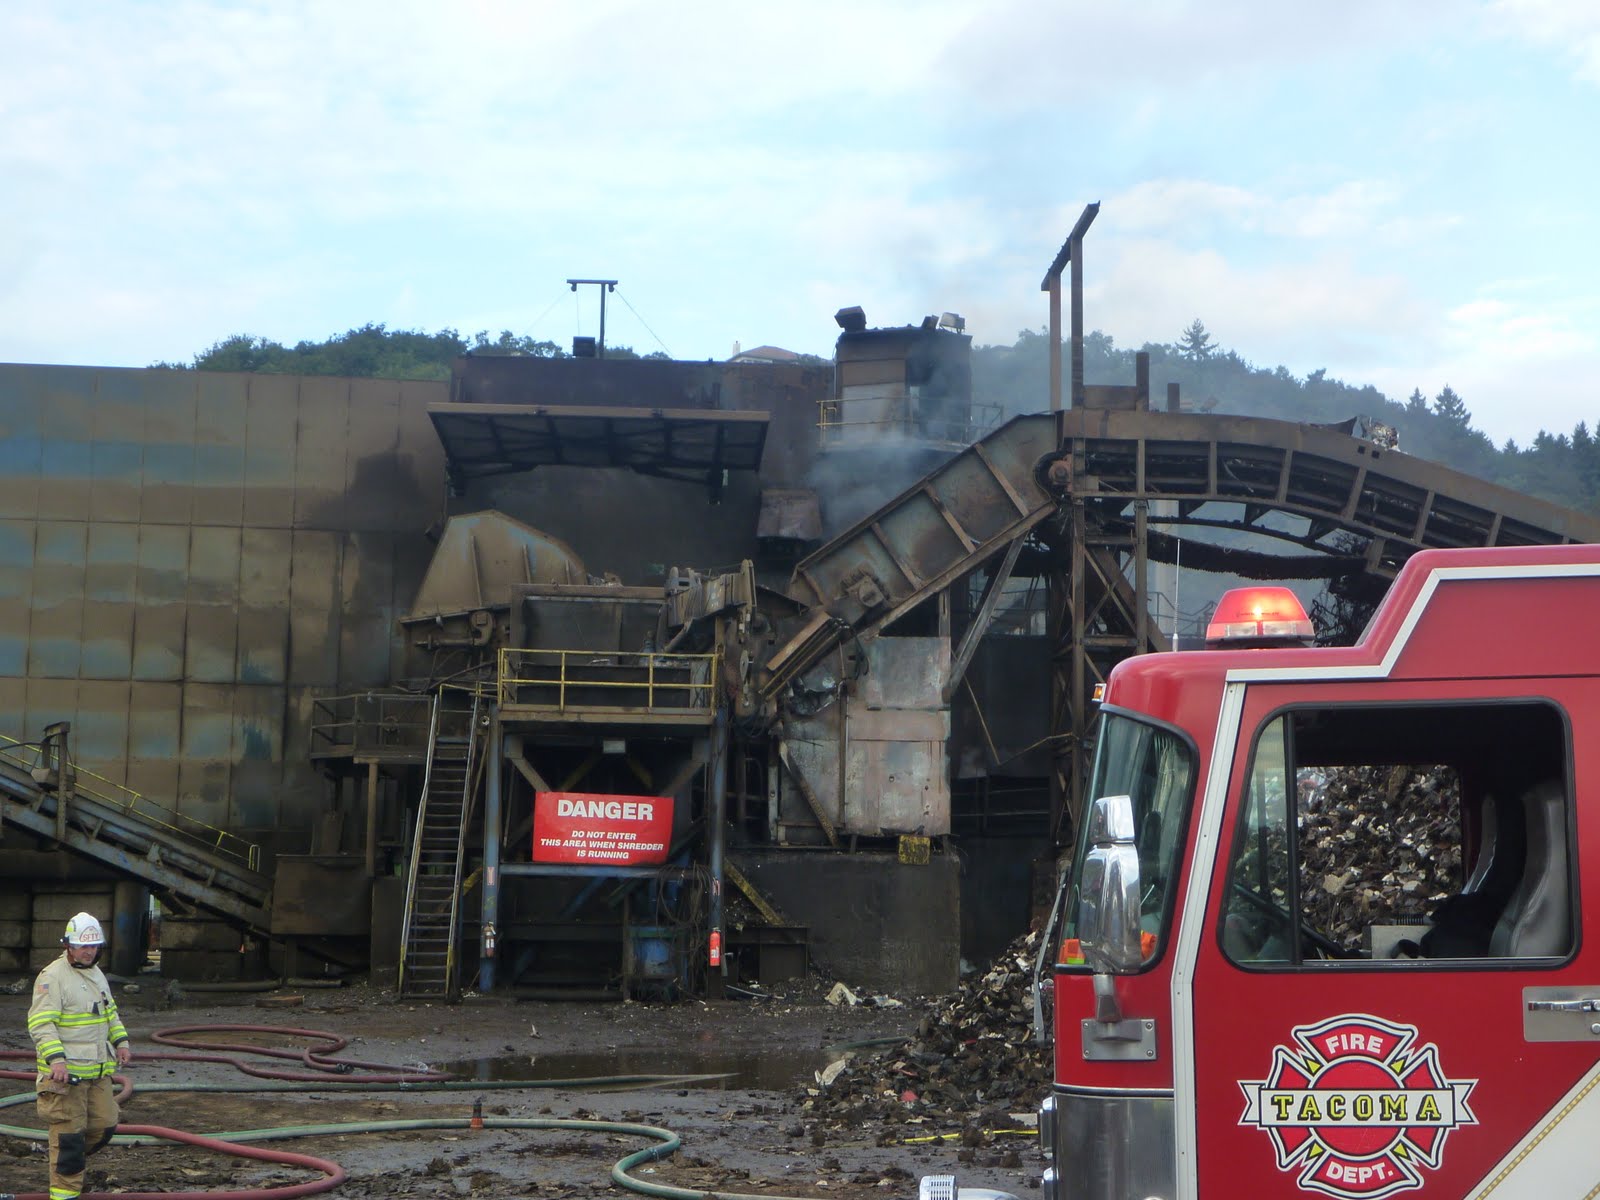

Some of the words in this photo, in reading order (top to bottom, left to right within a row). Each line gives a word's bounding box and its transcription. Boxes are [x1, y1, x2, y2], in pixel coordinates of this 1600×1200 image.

[557, 800, 653, 820] DANGER
[572, 830, 584, 838] DO
[587, 831, 605, 839] NOT
[607, 832, 636, 840] ENTER
[588, 850, 629, 859] RUNNING
[590, 841, 615, 849] WHEN
[618, 842, 663, 851] SHREDDER
[1325, 1034, 1383, 1054] FIRE
[1271, 1094, 1442, 1121] TACOMA
[1325, 1161, 1394, 1183] DEPT.
